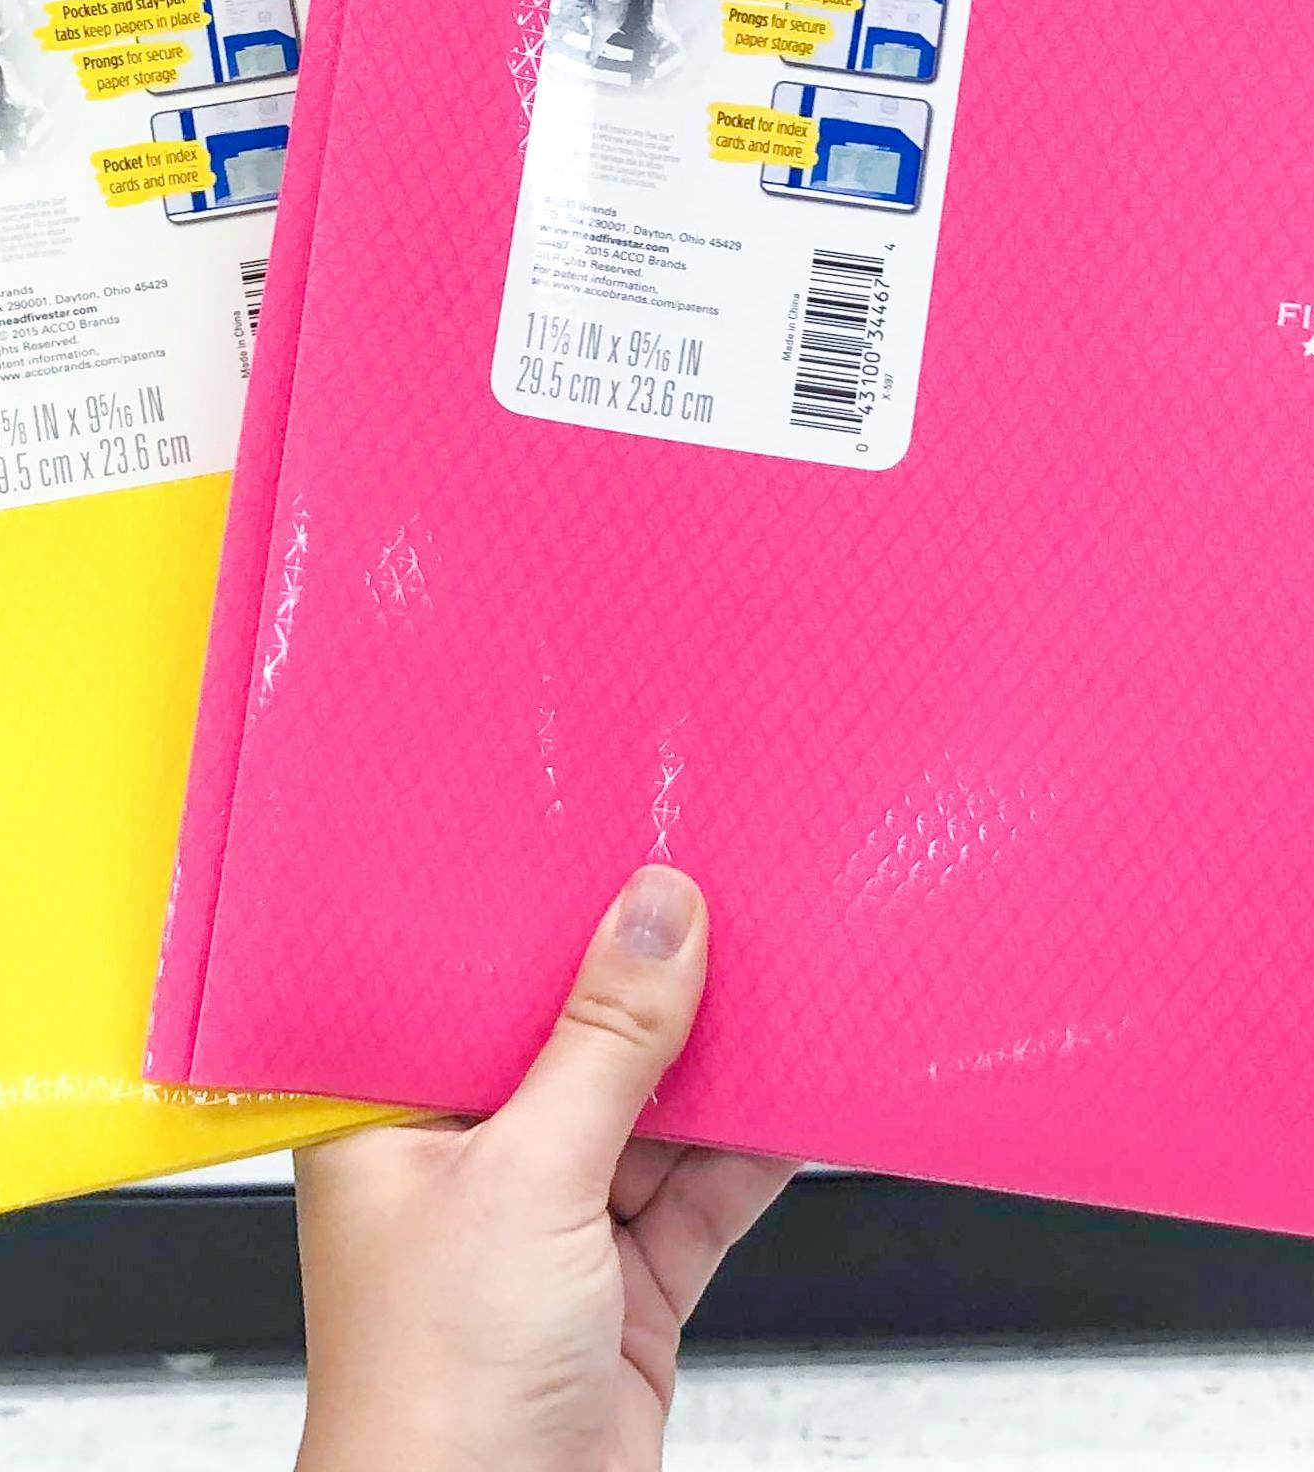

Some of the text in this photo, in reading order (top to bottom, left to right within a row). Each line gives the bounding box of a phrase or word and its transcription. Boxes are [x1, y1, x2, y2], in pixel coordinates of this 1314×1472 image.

[730, 9, 825, 33] Prongs for secure
[736, 33, 813, 55] paper storage
[717, 136, 802, 157] cards and more
[718, 112, 807, 137] Pocket for index
[867, 278, 891, 342] 34467
[576, 321, 604, 362] IN
[606, 335, 623, 365] x
[677, 337, 704, 377] IN
[515, 354, 715, 424] 29.5 cm x 23.6 cm
[857, 351, 882, 416] 43100
[33, 402, 60, 442] IN
[66, 407, 82, 437] x
[137, 384, 166, 425] IN
[39, 453, 74, 488] cm
[80, 450, 95, 482] x
[99, 432, 151, 478] 23.6
[157, 433, 192, 468] cm
